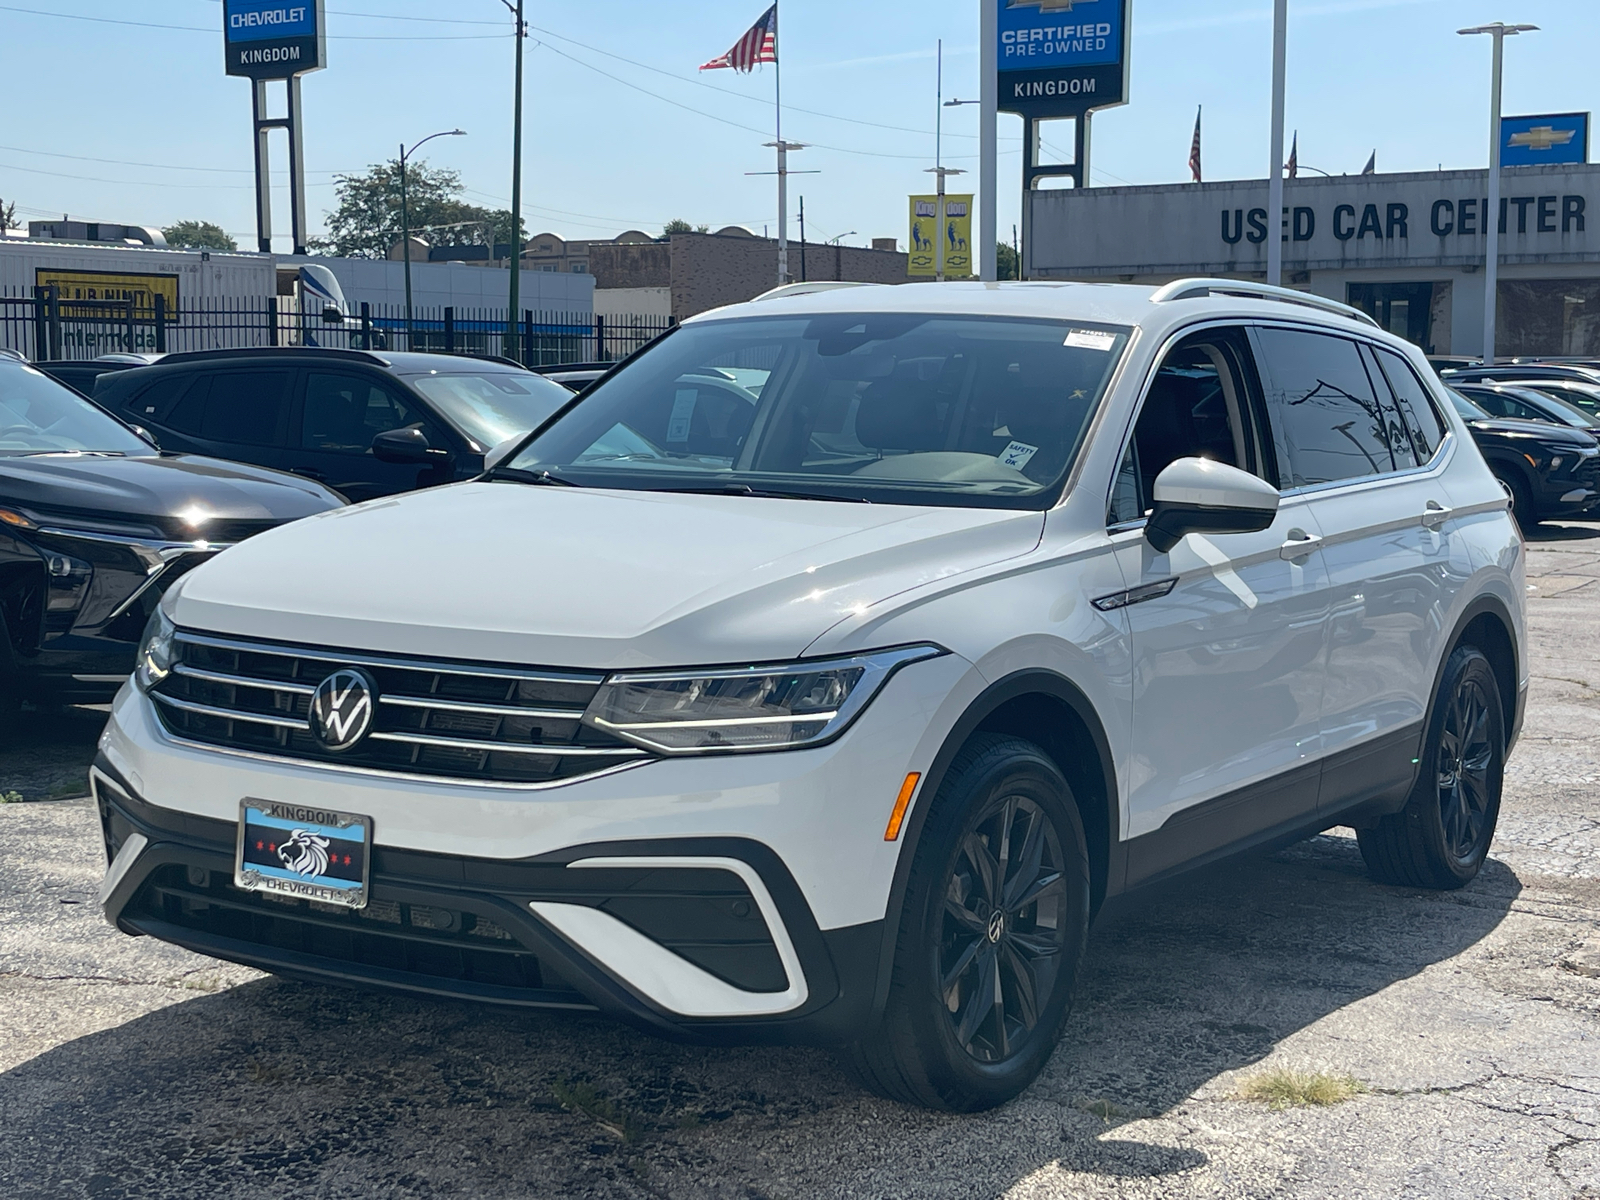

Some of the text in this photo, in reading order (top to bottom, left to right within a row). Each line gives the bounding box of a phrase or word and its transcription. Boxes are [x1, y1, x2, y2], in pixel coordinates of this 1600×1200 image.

[230, 7, 306, 28] CHEVROLET
[1001, 22, 1111, 44] CERTIFIED
[240, 46, 300, 64] KINGDOM
[1005, 38, 1106, 57] PRE-OWNED
[1014, 78, 1096, 97] KINGDOM
[915, 201, 967, 218] King dom
[1333, 203, 1408, 240] CAR
[1430, 195, 1586, 237] CENTER
[1008, 444, 1034, 455] SAFETY
[1005, 458, 1017, 466] OK
[271, 804, 338, 826] KINGDOM
[266, 879, 336, 900] CHEVROLET
